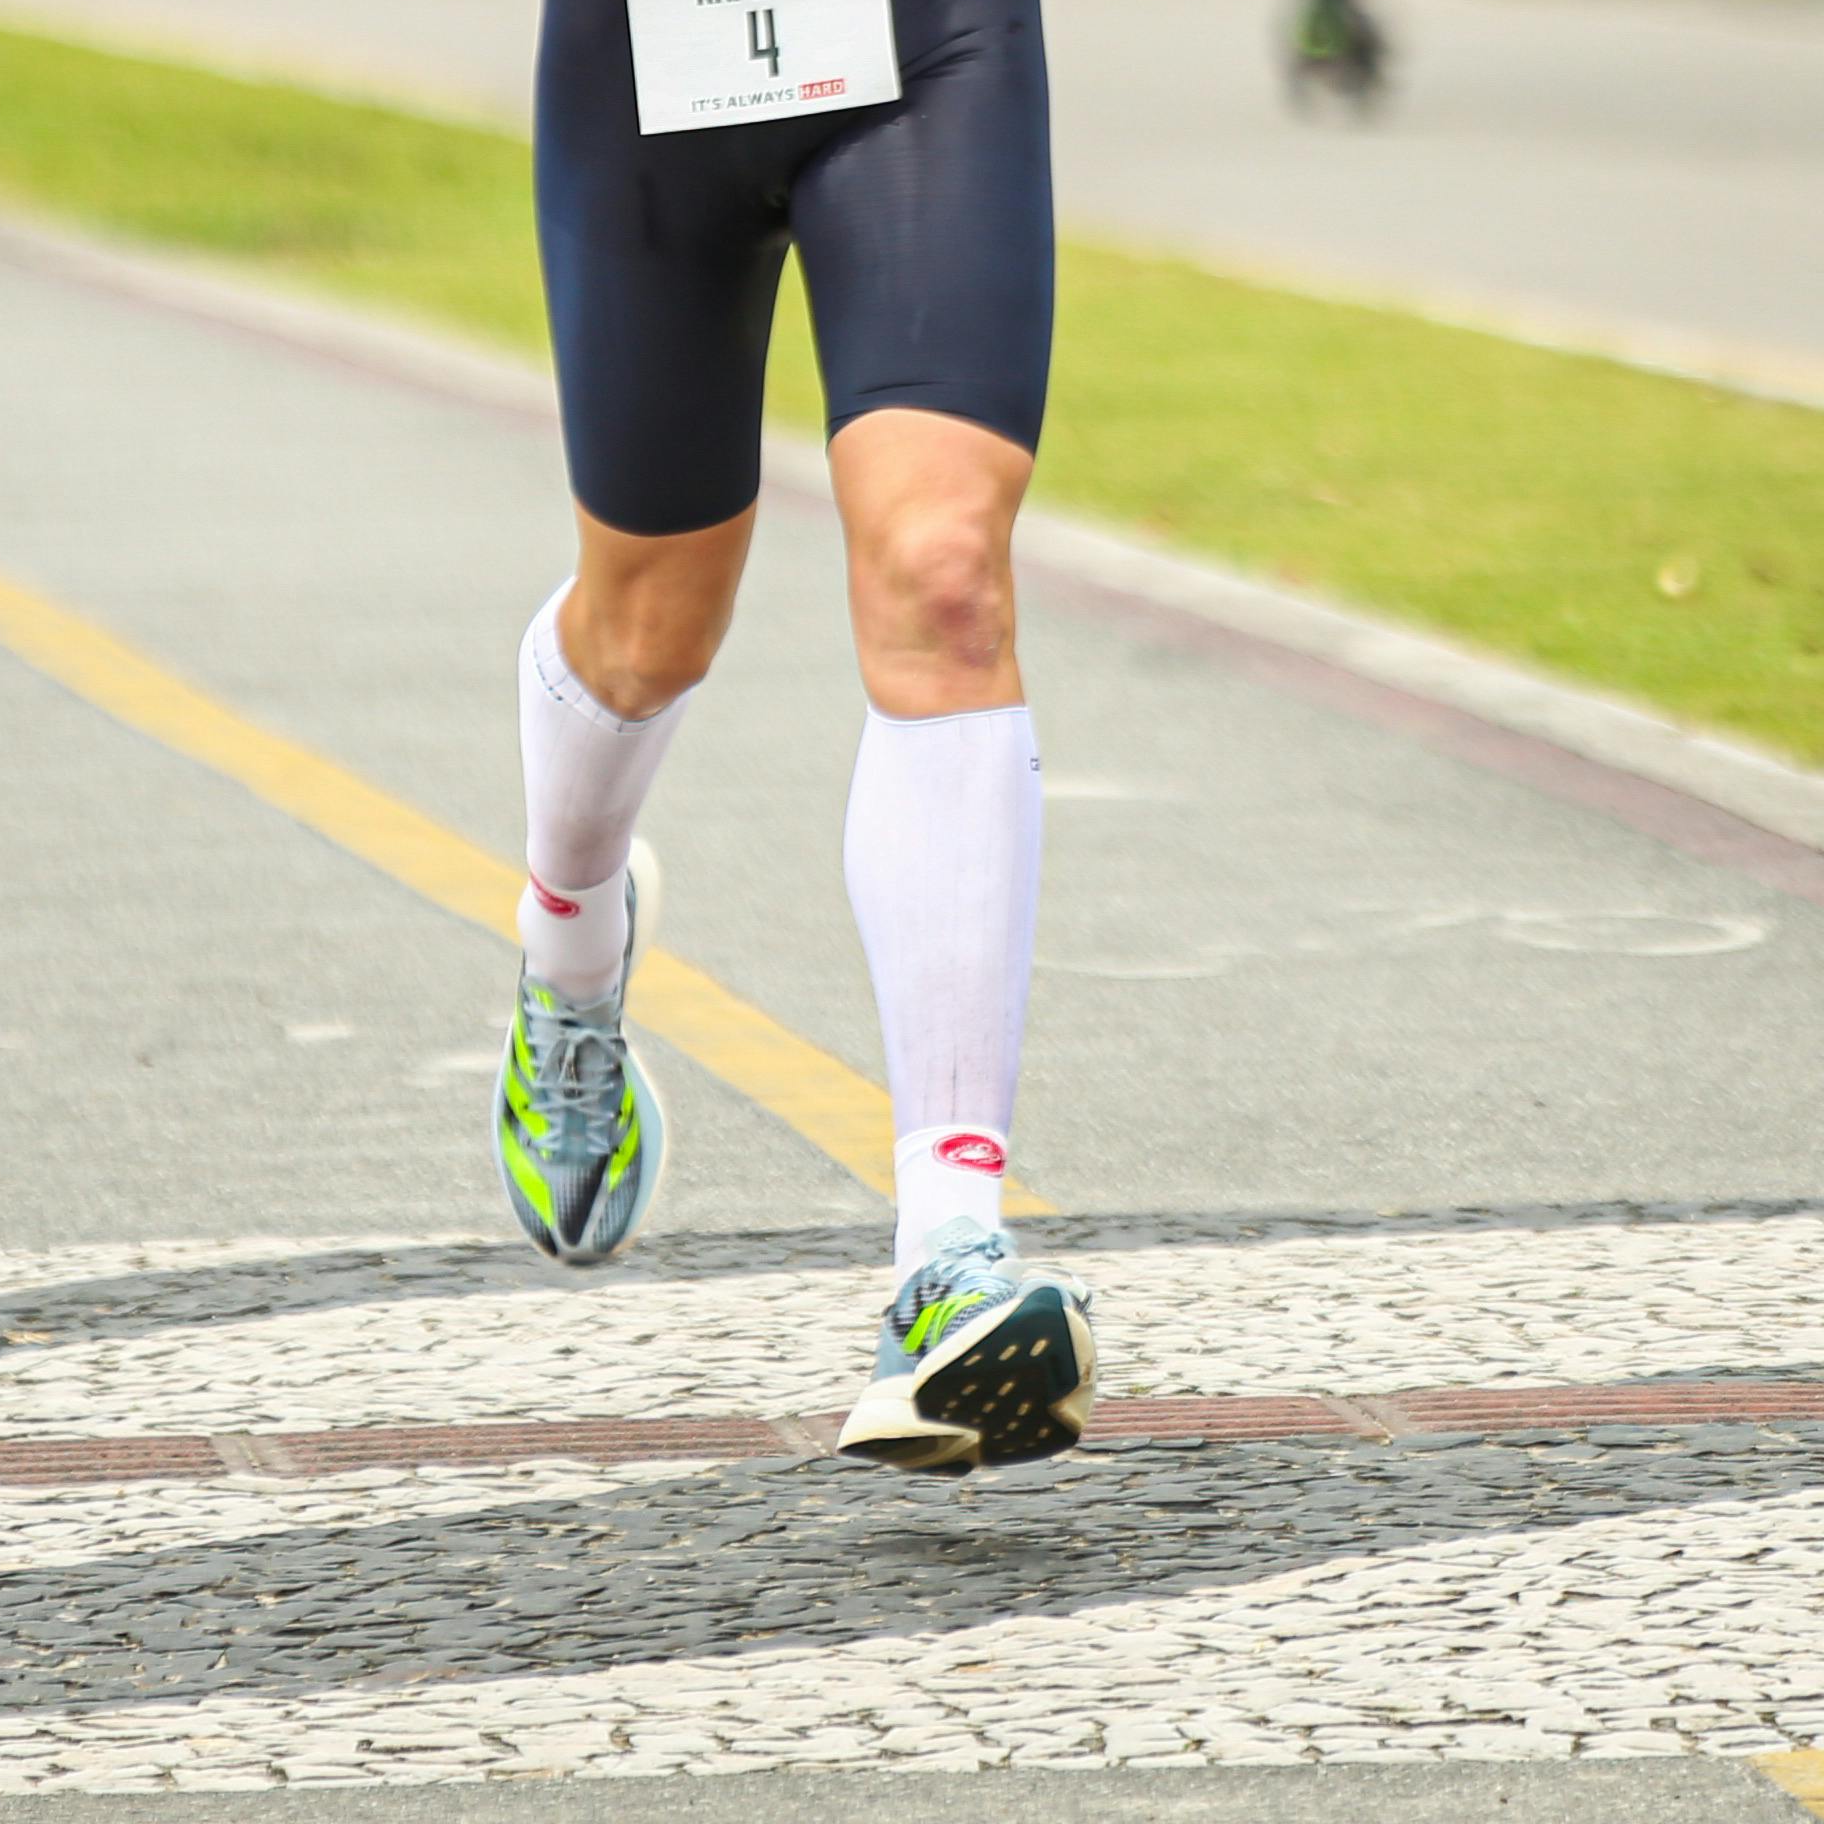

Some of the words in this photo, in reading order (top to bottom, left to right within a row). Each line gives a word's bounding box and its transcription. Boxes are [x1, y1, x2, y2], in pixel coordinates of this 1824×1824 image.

[745, 8, 780, 78] 4
[690, 97, 723, 113] IT'S
[726, 87, 795, 108] ALWAYS
[799, 79, 845, 98] HARD
